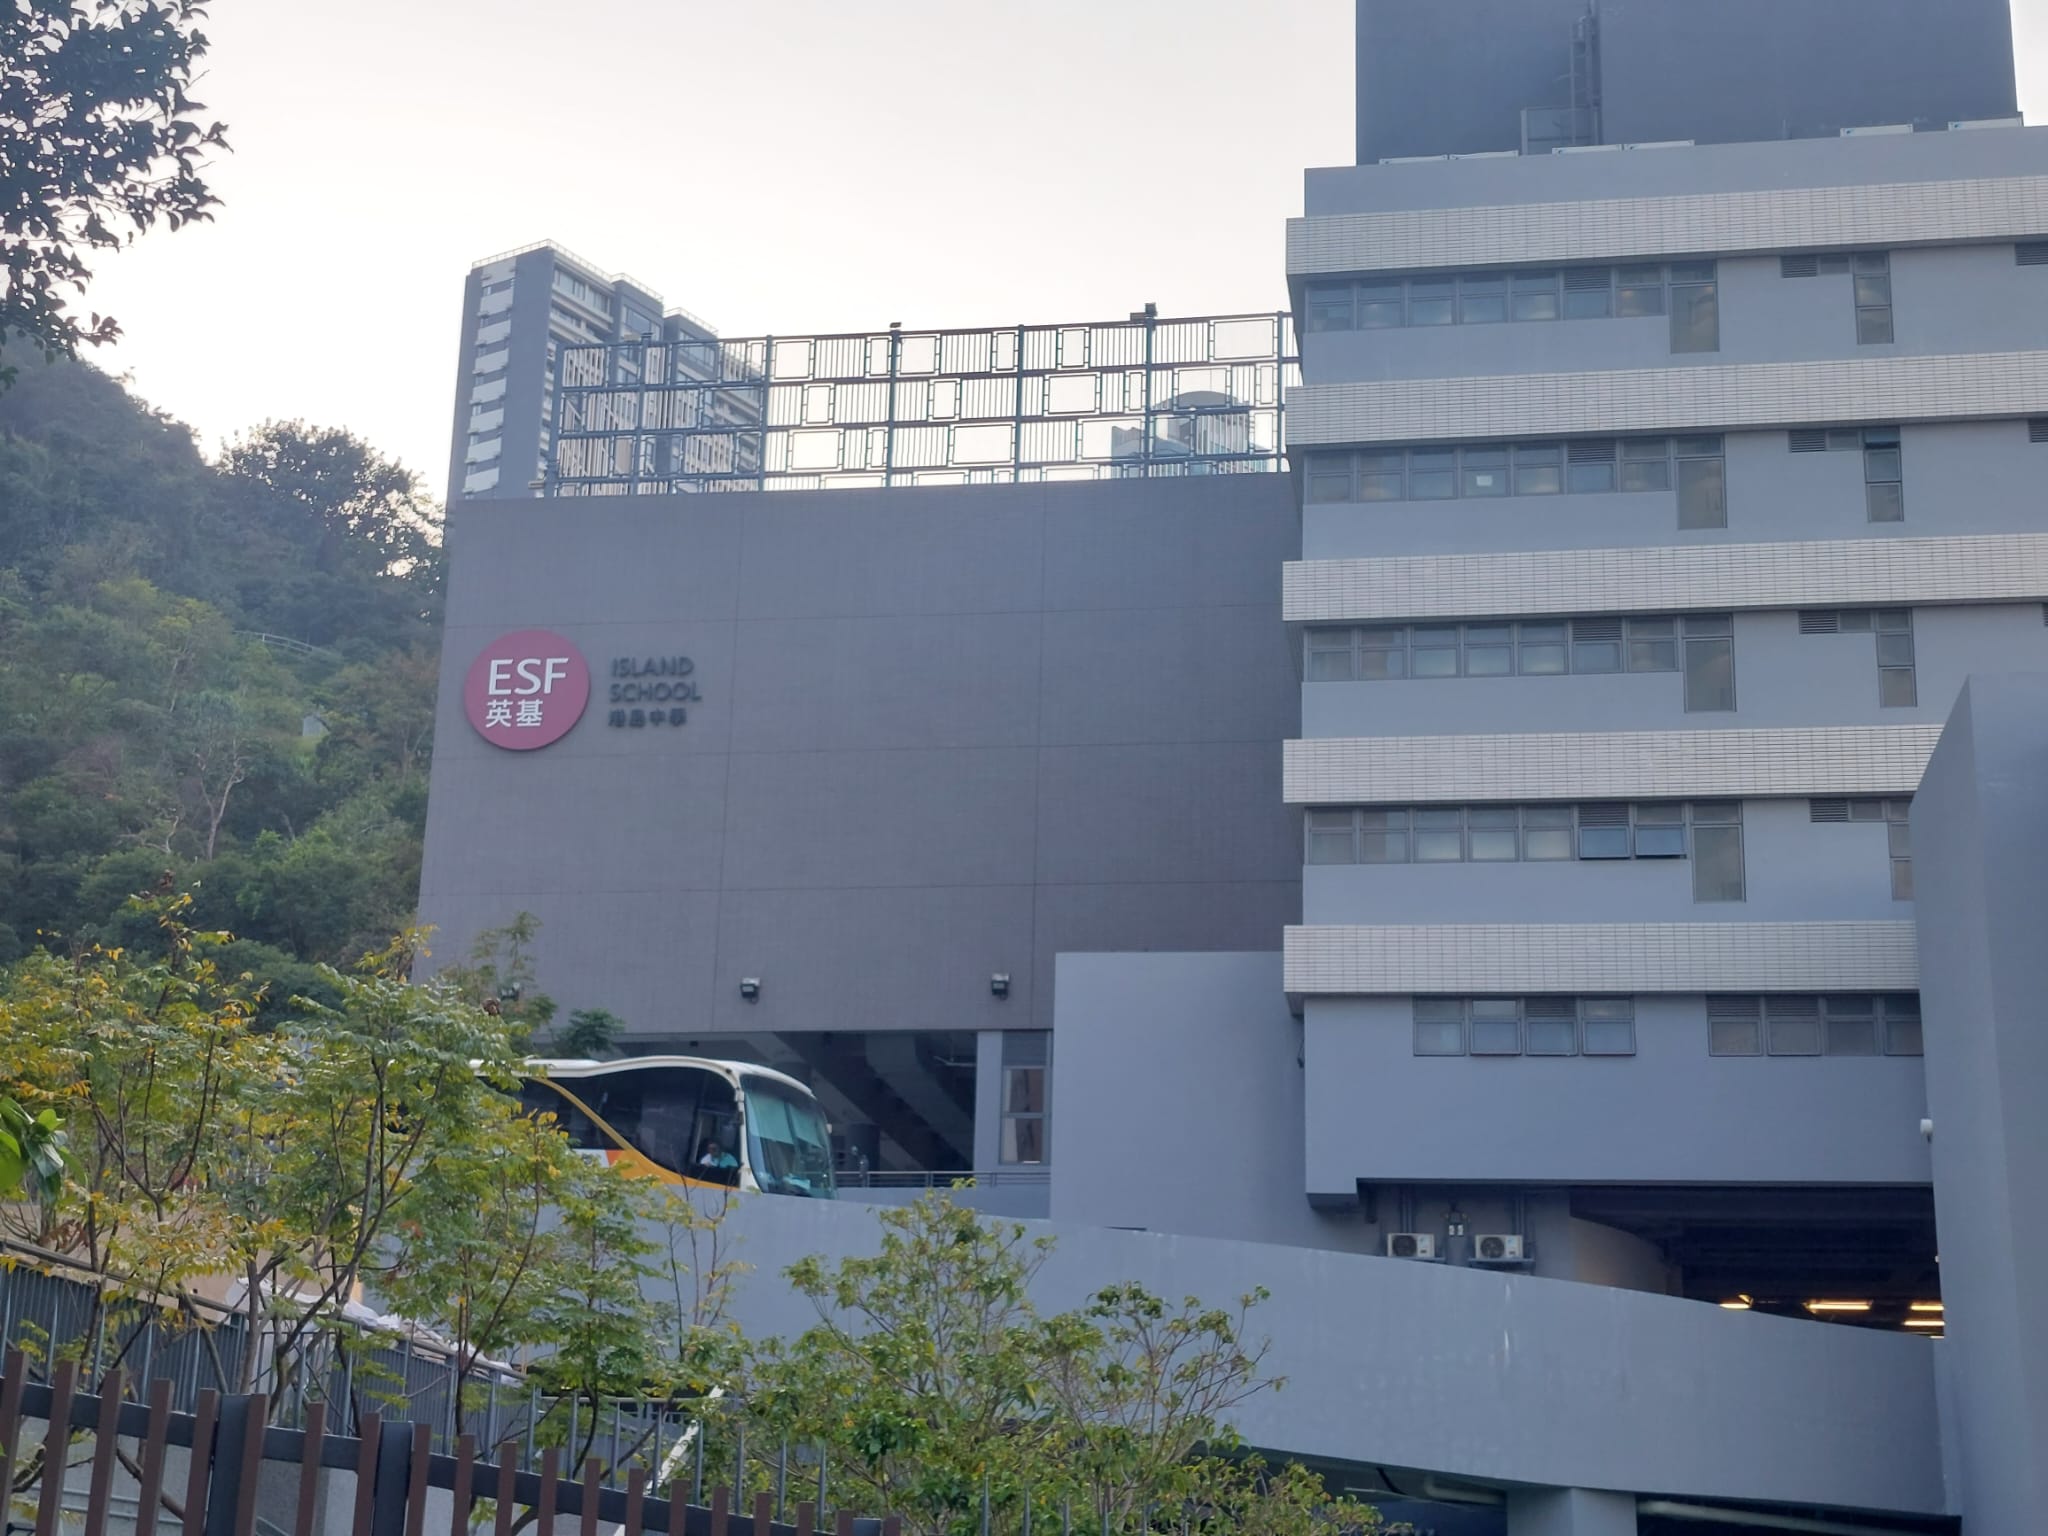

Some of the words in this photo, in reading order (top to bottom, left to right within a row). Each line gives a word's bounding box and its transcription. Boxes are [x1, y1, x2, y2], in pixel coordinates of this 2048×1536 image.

[488, 657, 569, 695] ESF
[611, 656, 695, 677] ISLAND
[609, 682, 702, 702] SCHOOL
[486, 699, 544, 728] 英基
